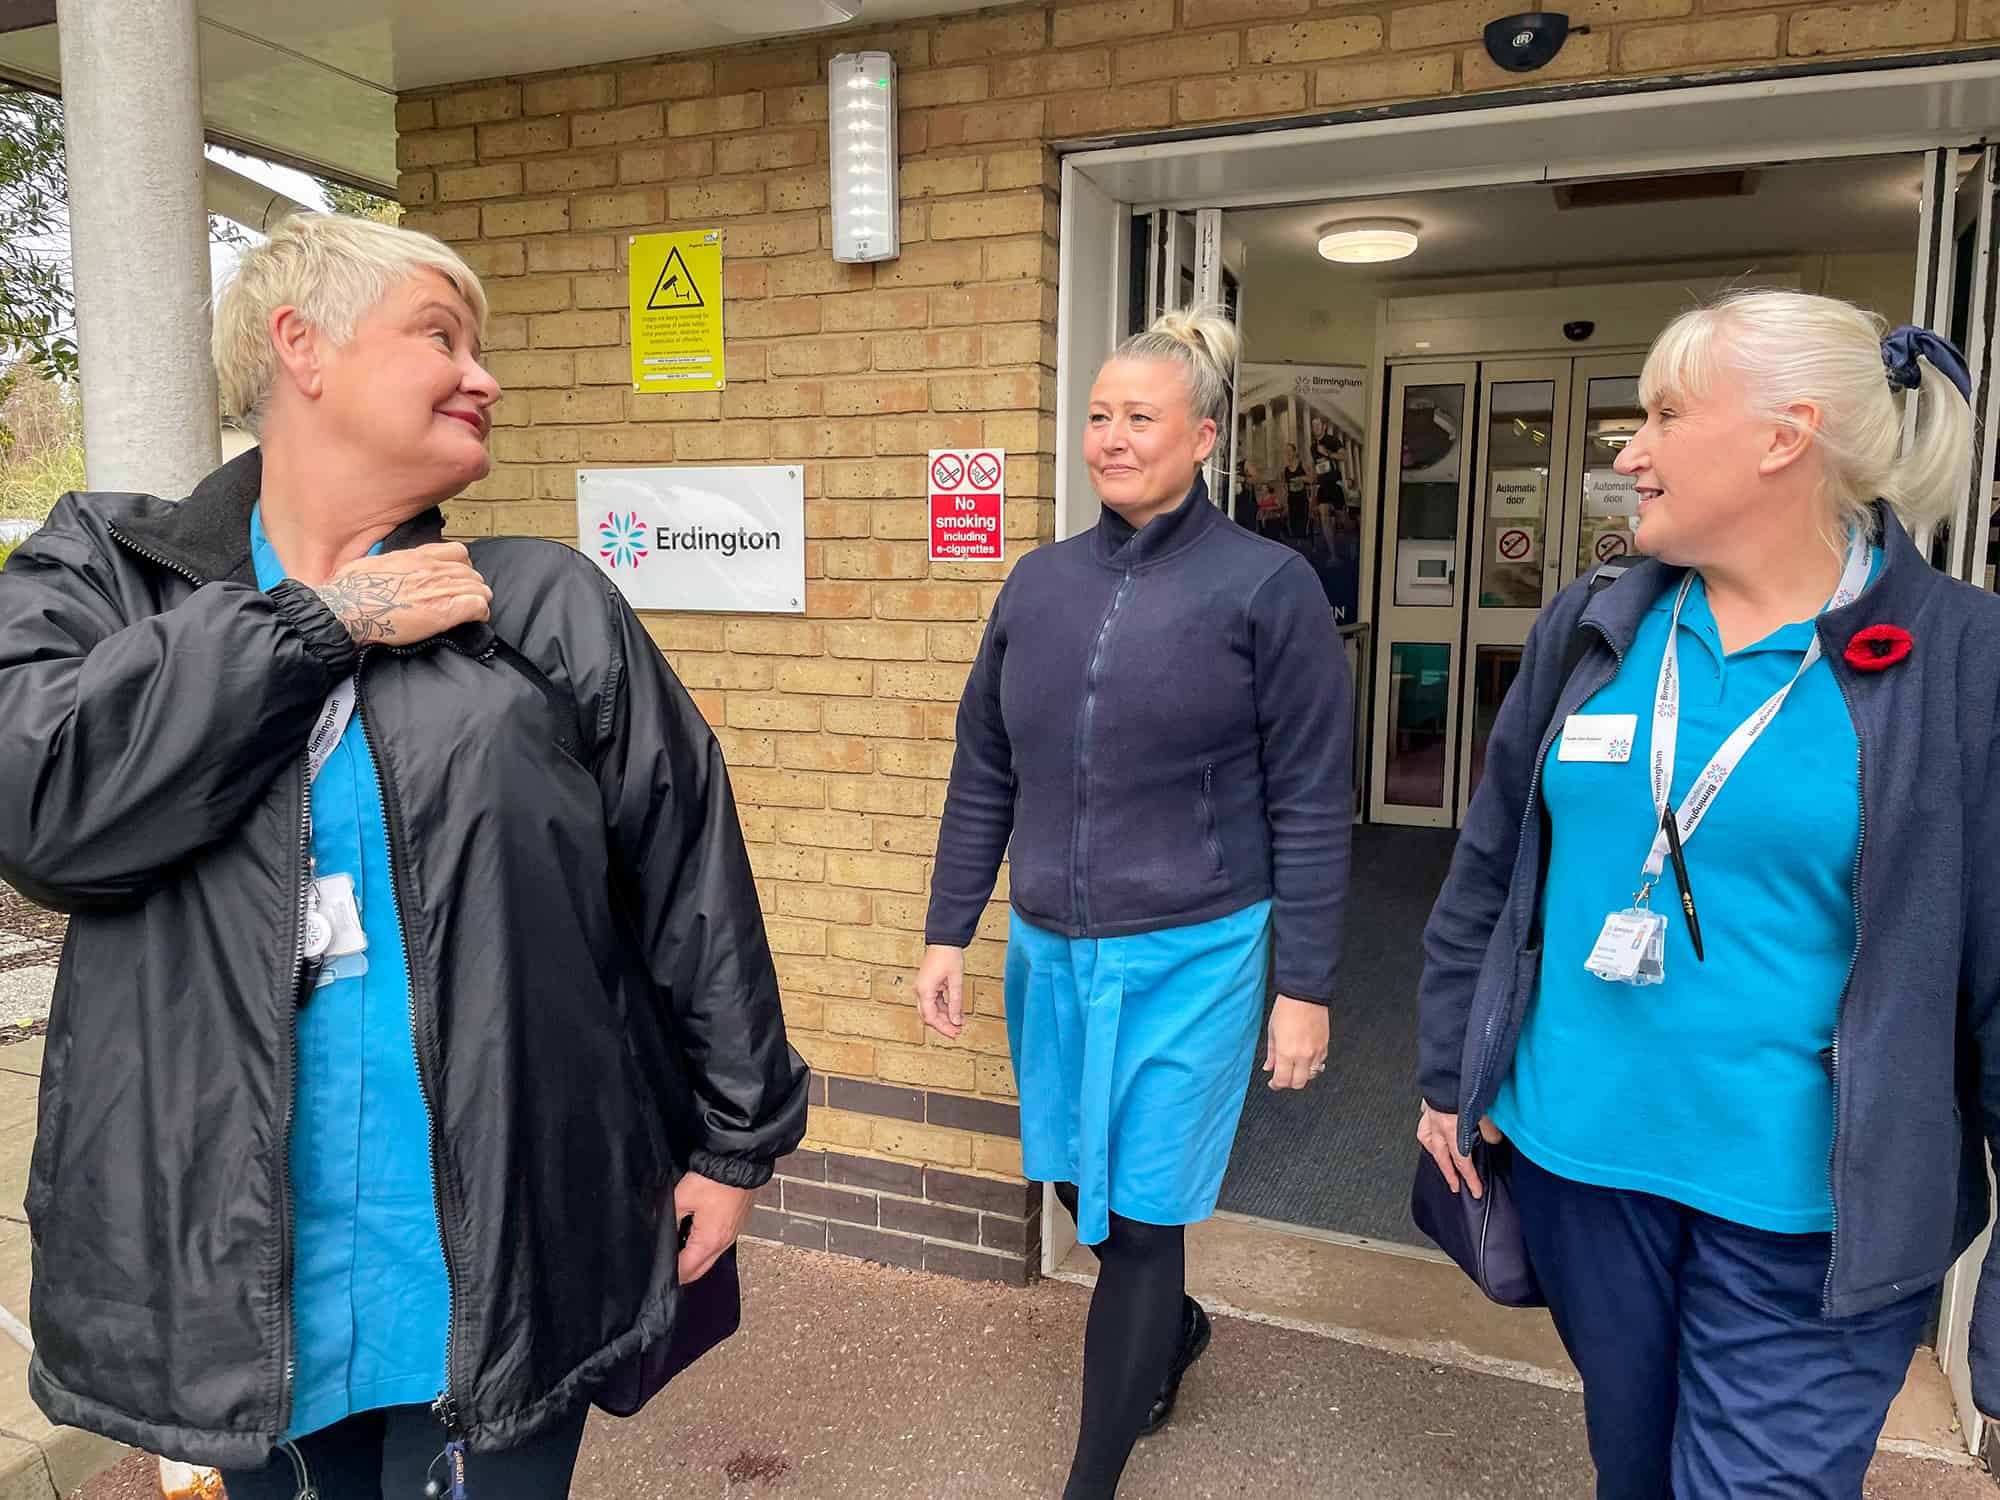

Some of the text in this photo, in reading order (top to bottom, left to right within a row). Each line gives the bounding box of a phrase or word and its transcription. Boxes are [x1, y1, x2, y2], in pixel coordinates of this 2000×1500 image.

[1312, 376, 1362, 388] Birmingham
[1496, 483, 1536, 494] Automatic
[955, 496, 976, 511] No
[1506, 495, 1525, 505] door
[1603, 494, 1623, 504] door
[936, 514, 996, 532] smoking
[656, 526, 781, 557] Erdington
[943, 531, 988, 543] including
[936, 544, 995, 556] e-cigarettes
[1660, 657, 1673, 701] Birmingham
[308, 700, 340, 753] Birmingham
[1683, 784, 1717, 832] Birmingham
